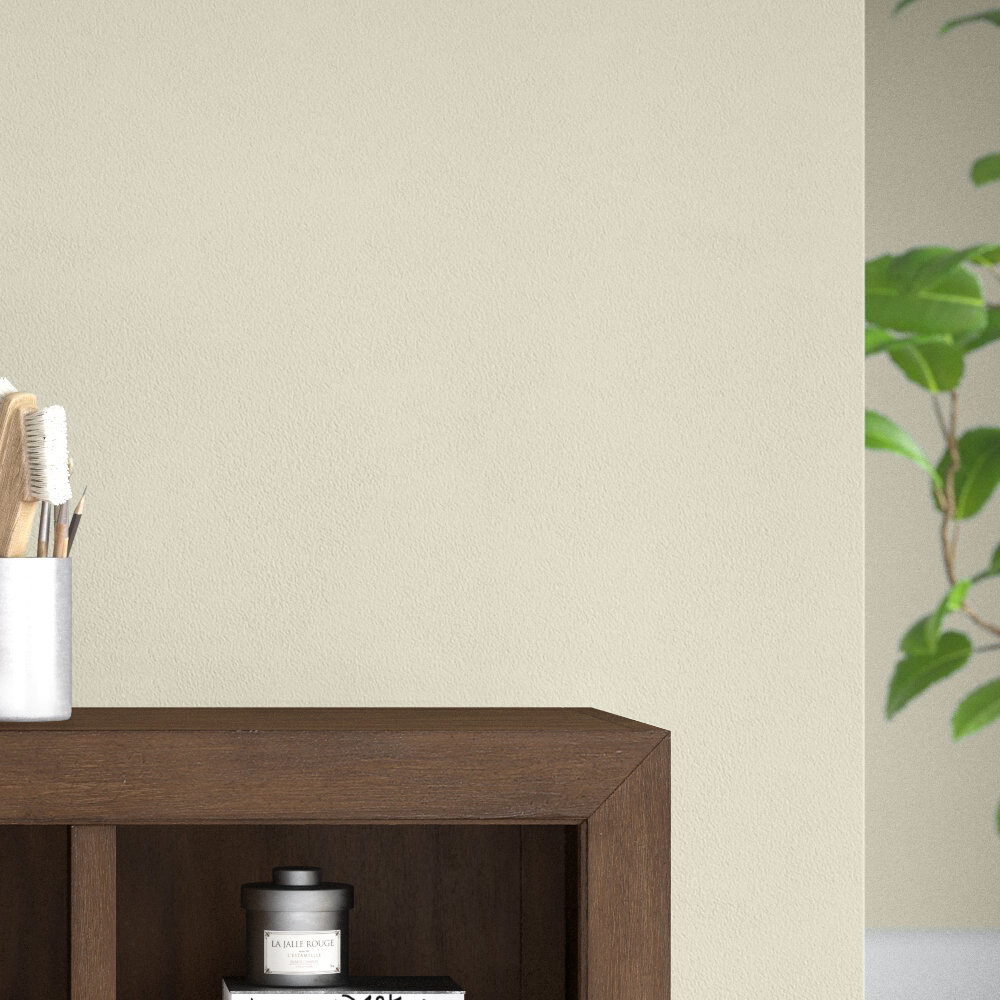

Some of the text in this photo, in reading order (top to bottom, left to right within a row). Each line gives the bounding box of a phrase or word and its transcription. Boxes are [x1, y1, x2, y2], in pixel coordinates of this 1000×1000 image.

[271, 939, 335, 949] LA JALLE ROUGE
